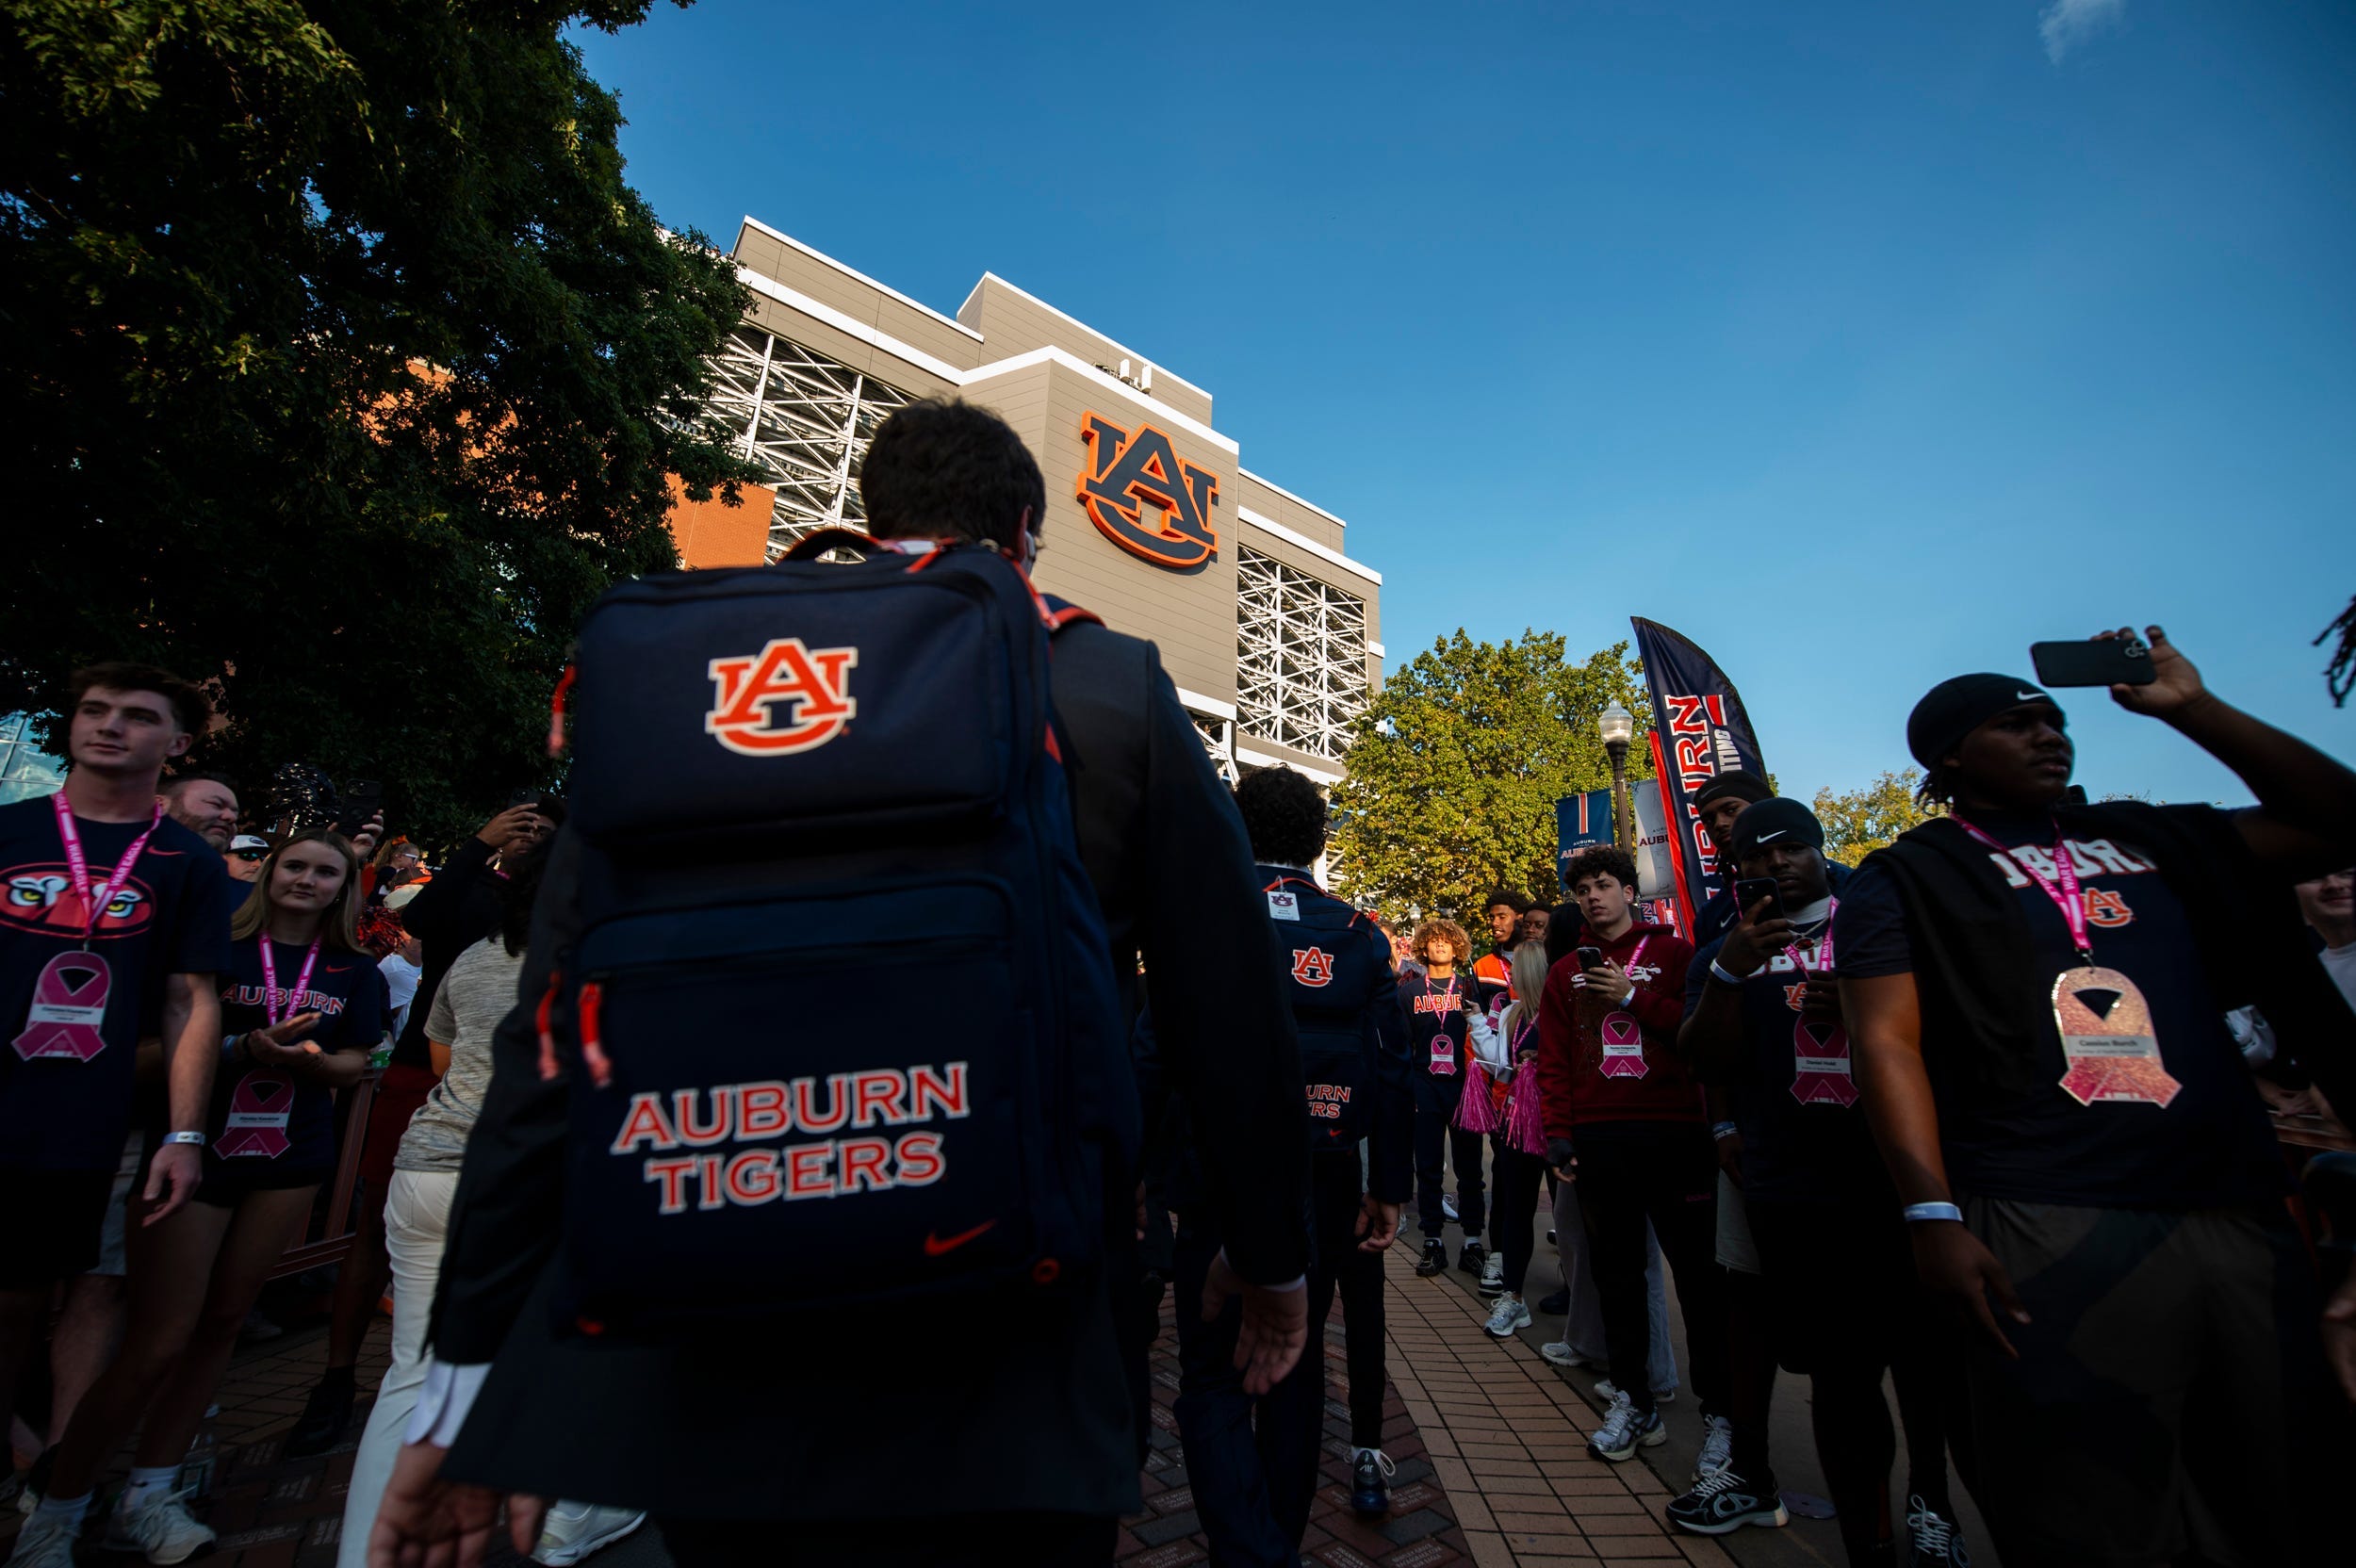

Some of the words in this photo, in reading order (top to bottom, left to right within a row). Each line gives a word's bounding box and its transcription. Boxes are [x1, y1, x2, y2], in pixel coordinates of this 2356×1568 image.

[1573, 839, 1596, 847] AUBURN
[2060, 869, 2075, 890] WAR
[219, 983, 348, 1018] AUBURN
[610, 1061, 970, 1155] AUBURN
[644, 1131, 946, 1216] TIGERS
